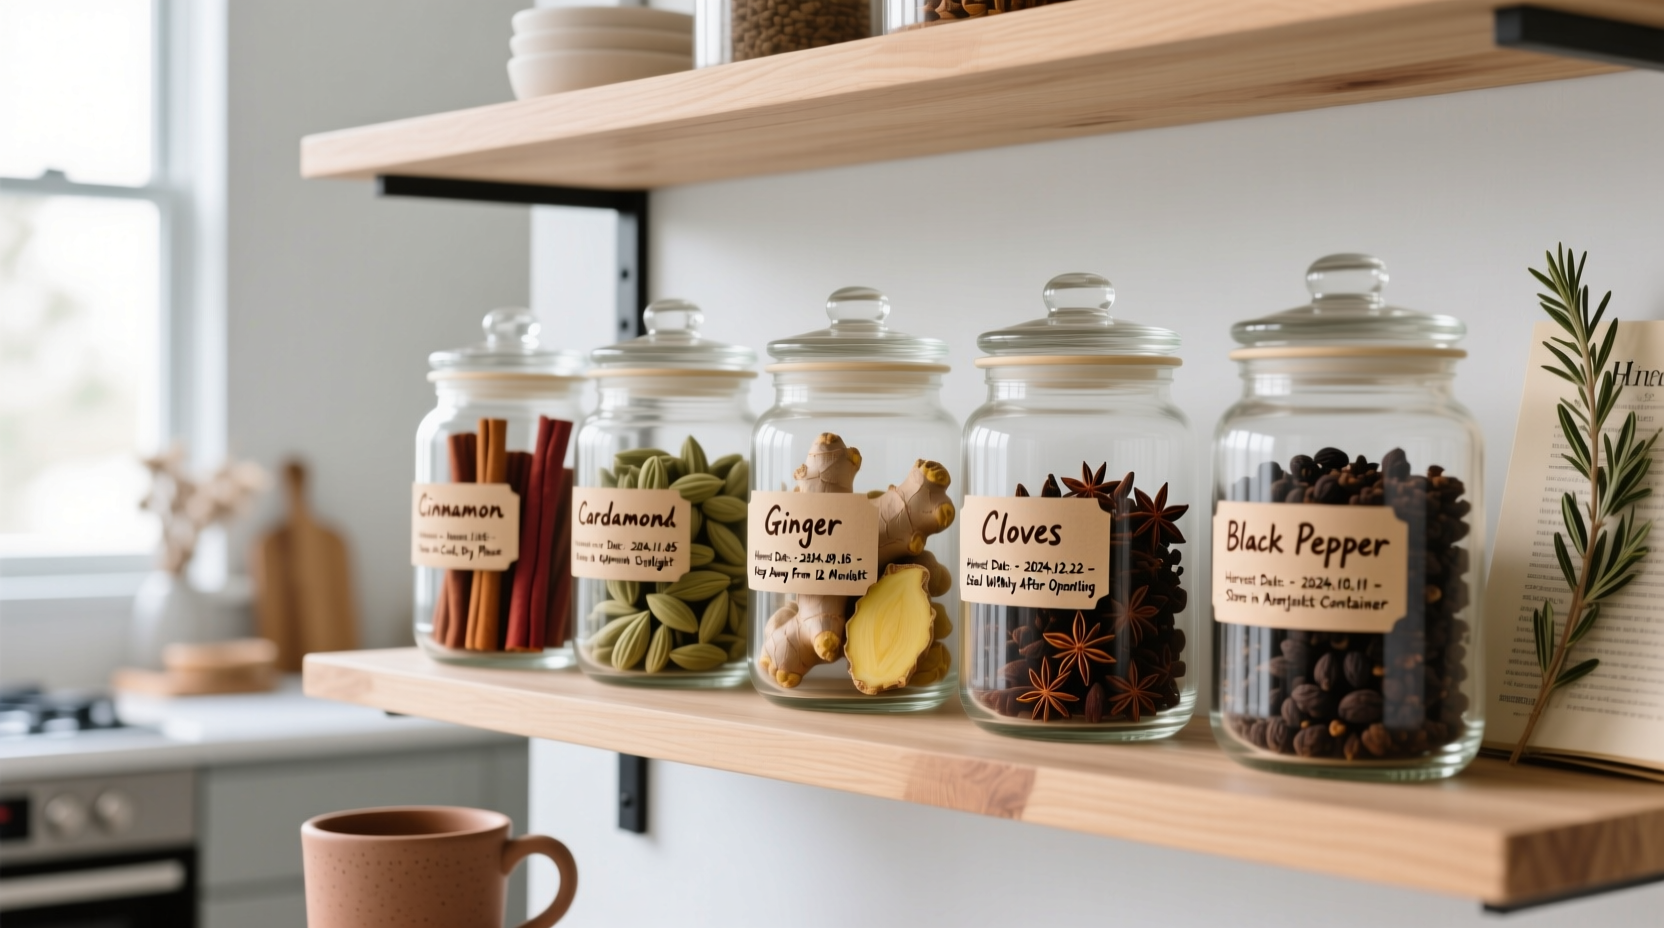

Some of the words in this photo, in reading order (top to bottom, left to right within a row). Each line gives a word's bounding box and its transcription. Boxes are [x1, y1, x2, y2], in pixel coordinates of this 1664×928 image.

[419, 493, 504, 518] Cinnamon
[765, 504, 842, 549] Ginger
[982, 510, 1062, 546] Cloves
[1227, 520, 1284, 554] Black
[1296, 522, 1391, 568] Pepper
[1024, 561, 1084, 575] 2024.12.22
[1301, 577, 1367, 591] 2024.10.11
